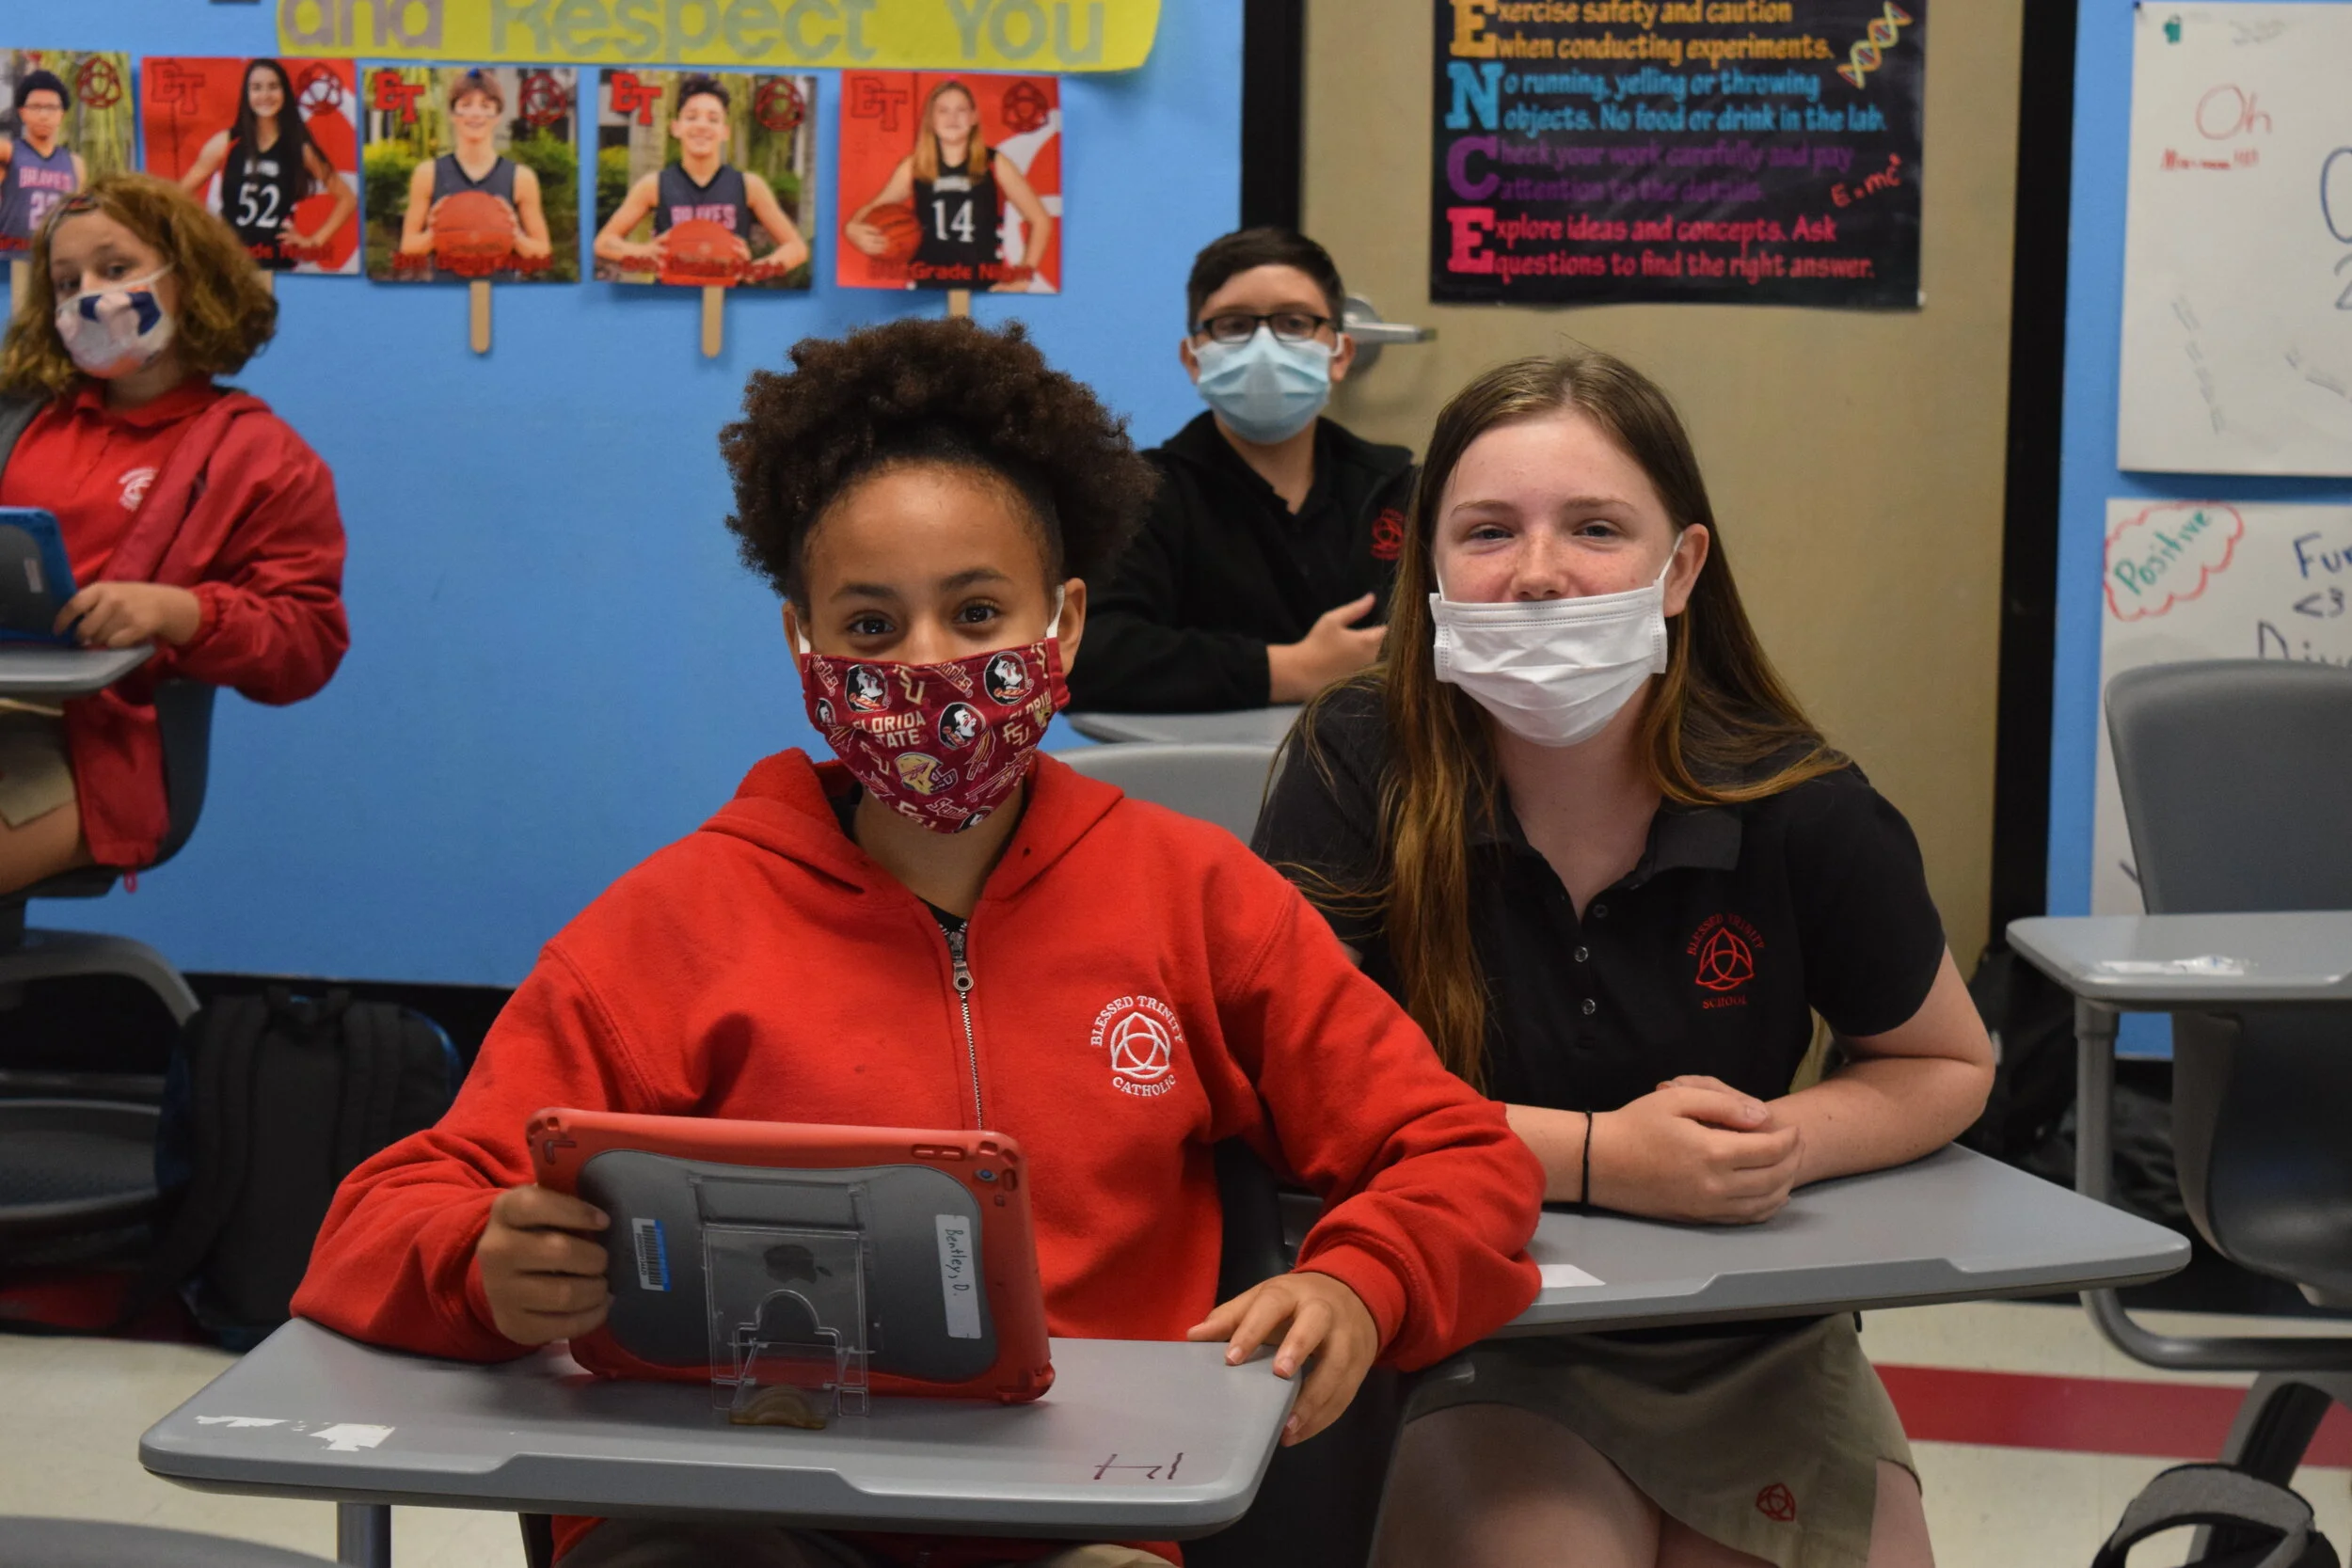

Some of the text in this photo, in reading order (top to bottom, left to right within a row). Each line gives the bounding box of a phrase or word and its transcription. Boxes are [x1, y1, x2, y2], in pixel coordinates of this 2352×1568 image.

[283, 0, 1104, 65] and Respect You
[1582, 0, 1659, 30] safety
[1660, 0, 1703, 24] and
[1706, 0, 1793, 24] caution
[1497, 31, 1836, 70] when conducting experiments.
[1613, 66, 1687, 103] yelling
[1691, 73, 1718, 95] or
[1720, 67, 1821, 102] throwing
[1600, 103, 1631, 131] No
[1635, 102, 1686, 131] food
[1689, 109, 1715, 131] or
[1717, 103, 1776, 131] drink
[1779, 103, 1802, 131] in
[1804, 103, 1845, 131] the
[2195, 83, 2273, 141] Oh
[235, 182, 281, 228] 52
[931, 198, 976, 243] 14
[1567, 213, 1629, 241] ideas
[1630, 213, 1674, 241] and
[1677, 217, 1788, 258] concepts.
[1791, 213, 1837, 242] Ask
[1494, 249, 1607, 285] questions
[1611, 251, 1637, 277] to
[1641, 248, 1683, 277] find
[1687, 248, 1724, 277] the
[1729, 248, 1787, 285] right
[1090, 995, 1184, 1047] BLESSED TRINITY
[1112, 1073, 1177, 1097] CATHOLIC
